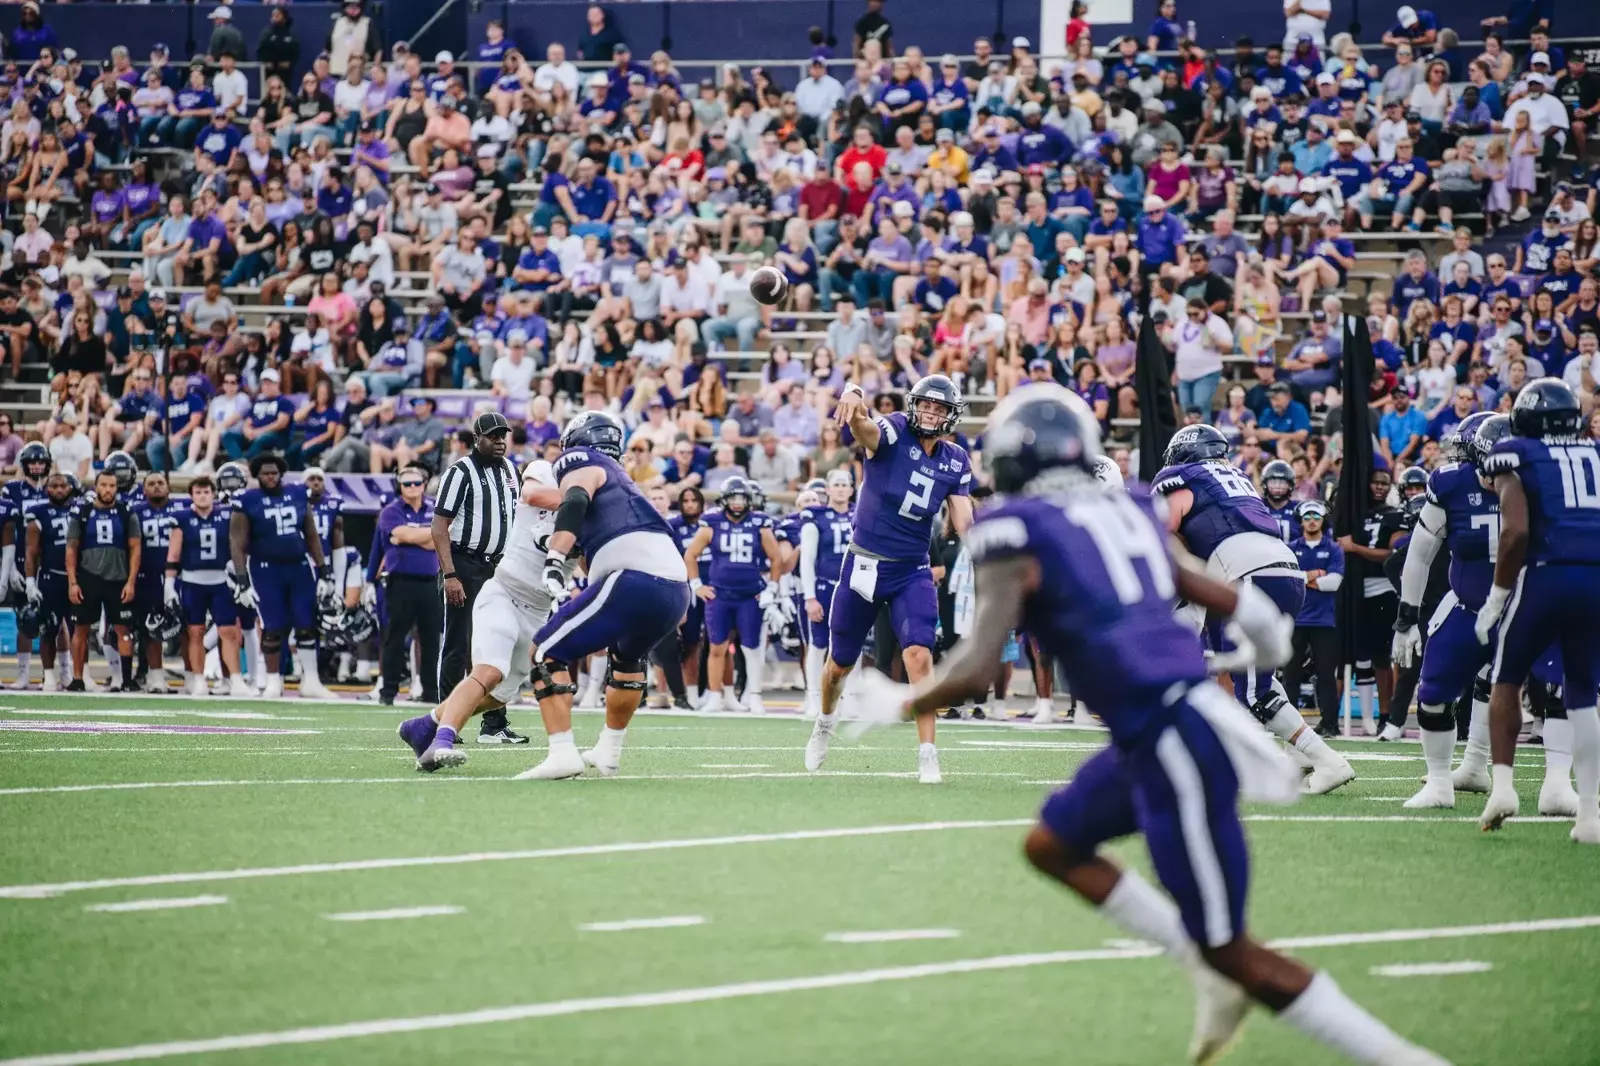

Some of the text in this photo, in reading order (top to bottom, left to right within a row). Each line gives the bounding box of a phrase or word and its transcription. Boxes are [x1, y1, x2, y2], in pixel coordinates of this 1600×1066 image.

[1549, 446, 1600, 508] 10
[898, 470, 935, 521] 2
[96, 519, 113, 544] 8
[142, 518, 172, 548] 93
[264, 506, 297, 536] 72
[1363, 522, 1381, 549] 7
[200, 528, 217, 560] 9
[720, 533, 753, 563] 46
[1470, 513, 1503, 564] 7
